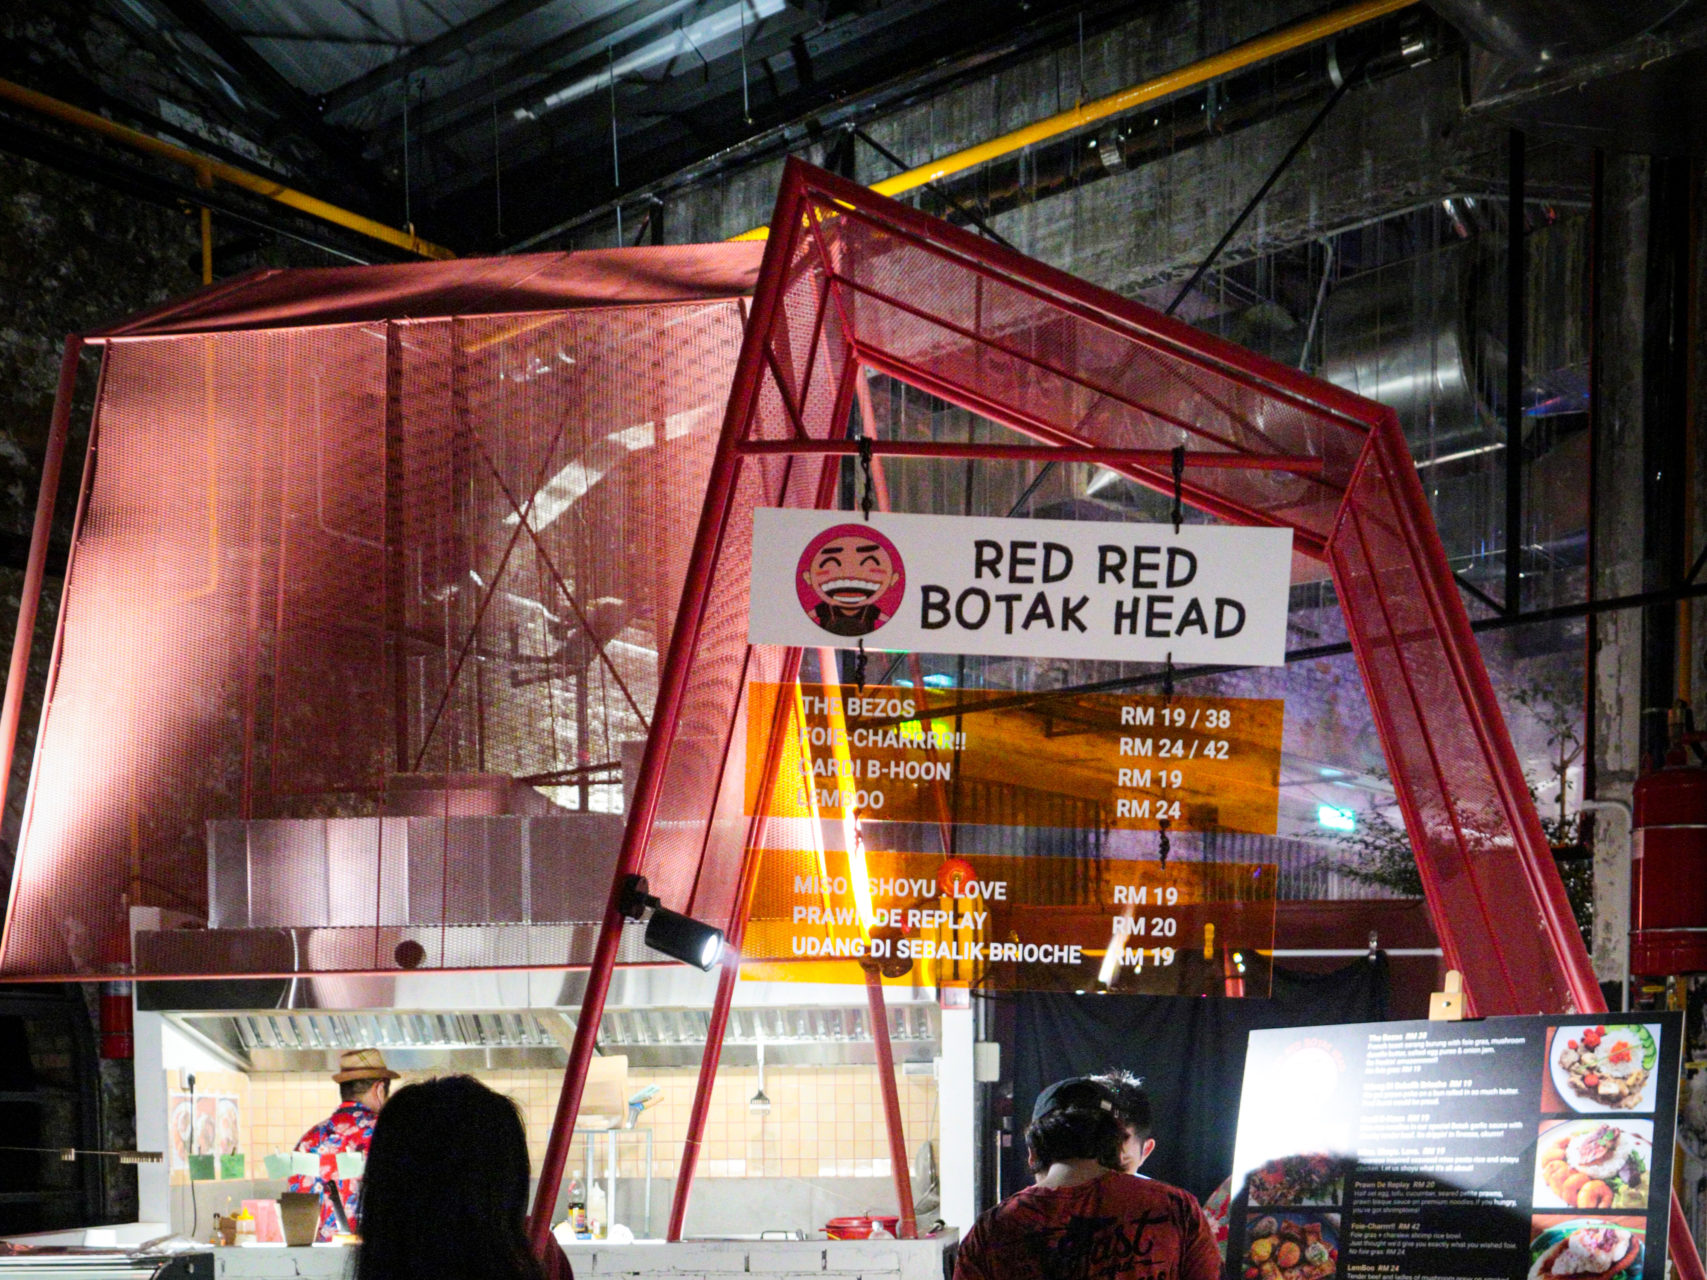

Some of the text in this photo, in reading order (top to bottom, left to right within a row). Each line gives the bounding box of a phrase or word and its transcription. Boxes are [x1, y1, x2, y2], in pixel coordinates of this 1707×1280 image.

[974, 540, 1197, 588] RED RED
[921, 584, 1246, 638] BOTAK HEAD
[801, 696, 916, 718] THE BEZOS
[1121, 706, 1230, 728] RM 19 / 38
[1120, 737, 1229, 759] RM 24 / 42
[800, 758, 951, 780] CARDI B-HOON
[1118, 768, 1182, 788] RM 19
[1117, 799, 1181, 819] RM 24
[794, 876, 847, 894] MISO
[869, 877, 936, 898] SHOYU
[953, 880, 1007, 900] LOVE
[1114, 885, 1177, 905] RM 19
[876, 908, 902, 927] DE
[908, 909, 987, 930] REPLAY
[1112, 916, 1176, 936] RM 20
[792, 936, 1082, 964] UDANG DI SEBALIK BRIOCHE
[1152, 946, 1174, 966] 19
[1387, 1181, 1410, 1190] Replay
